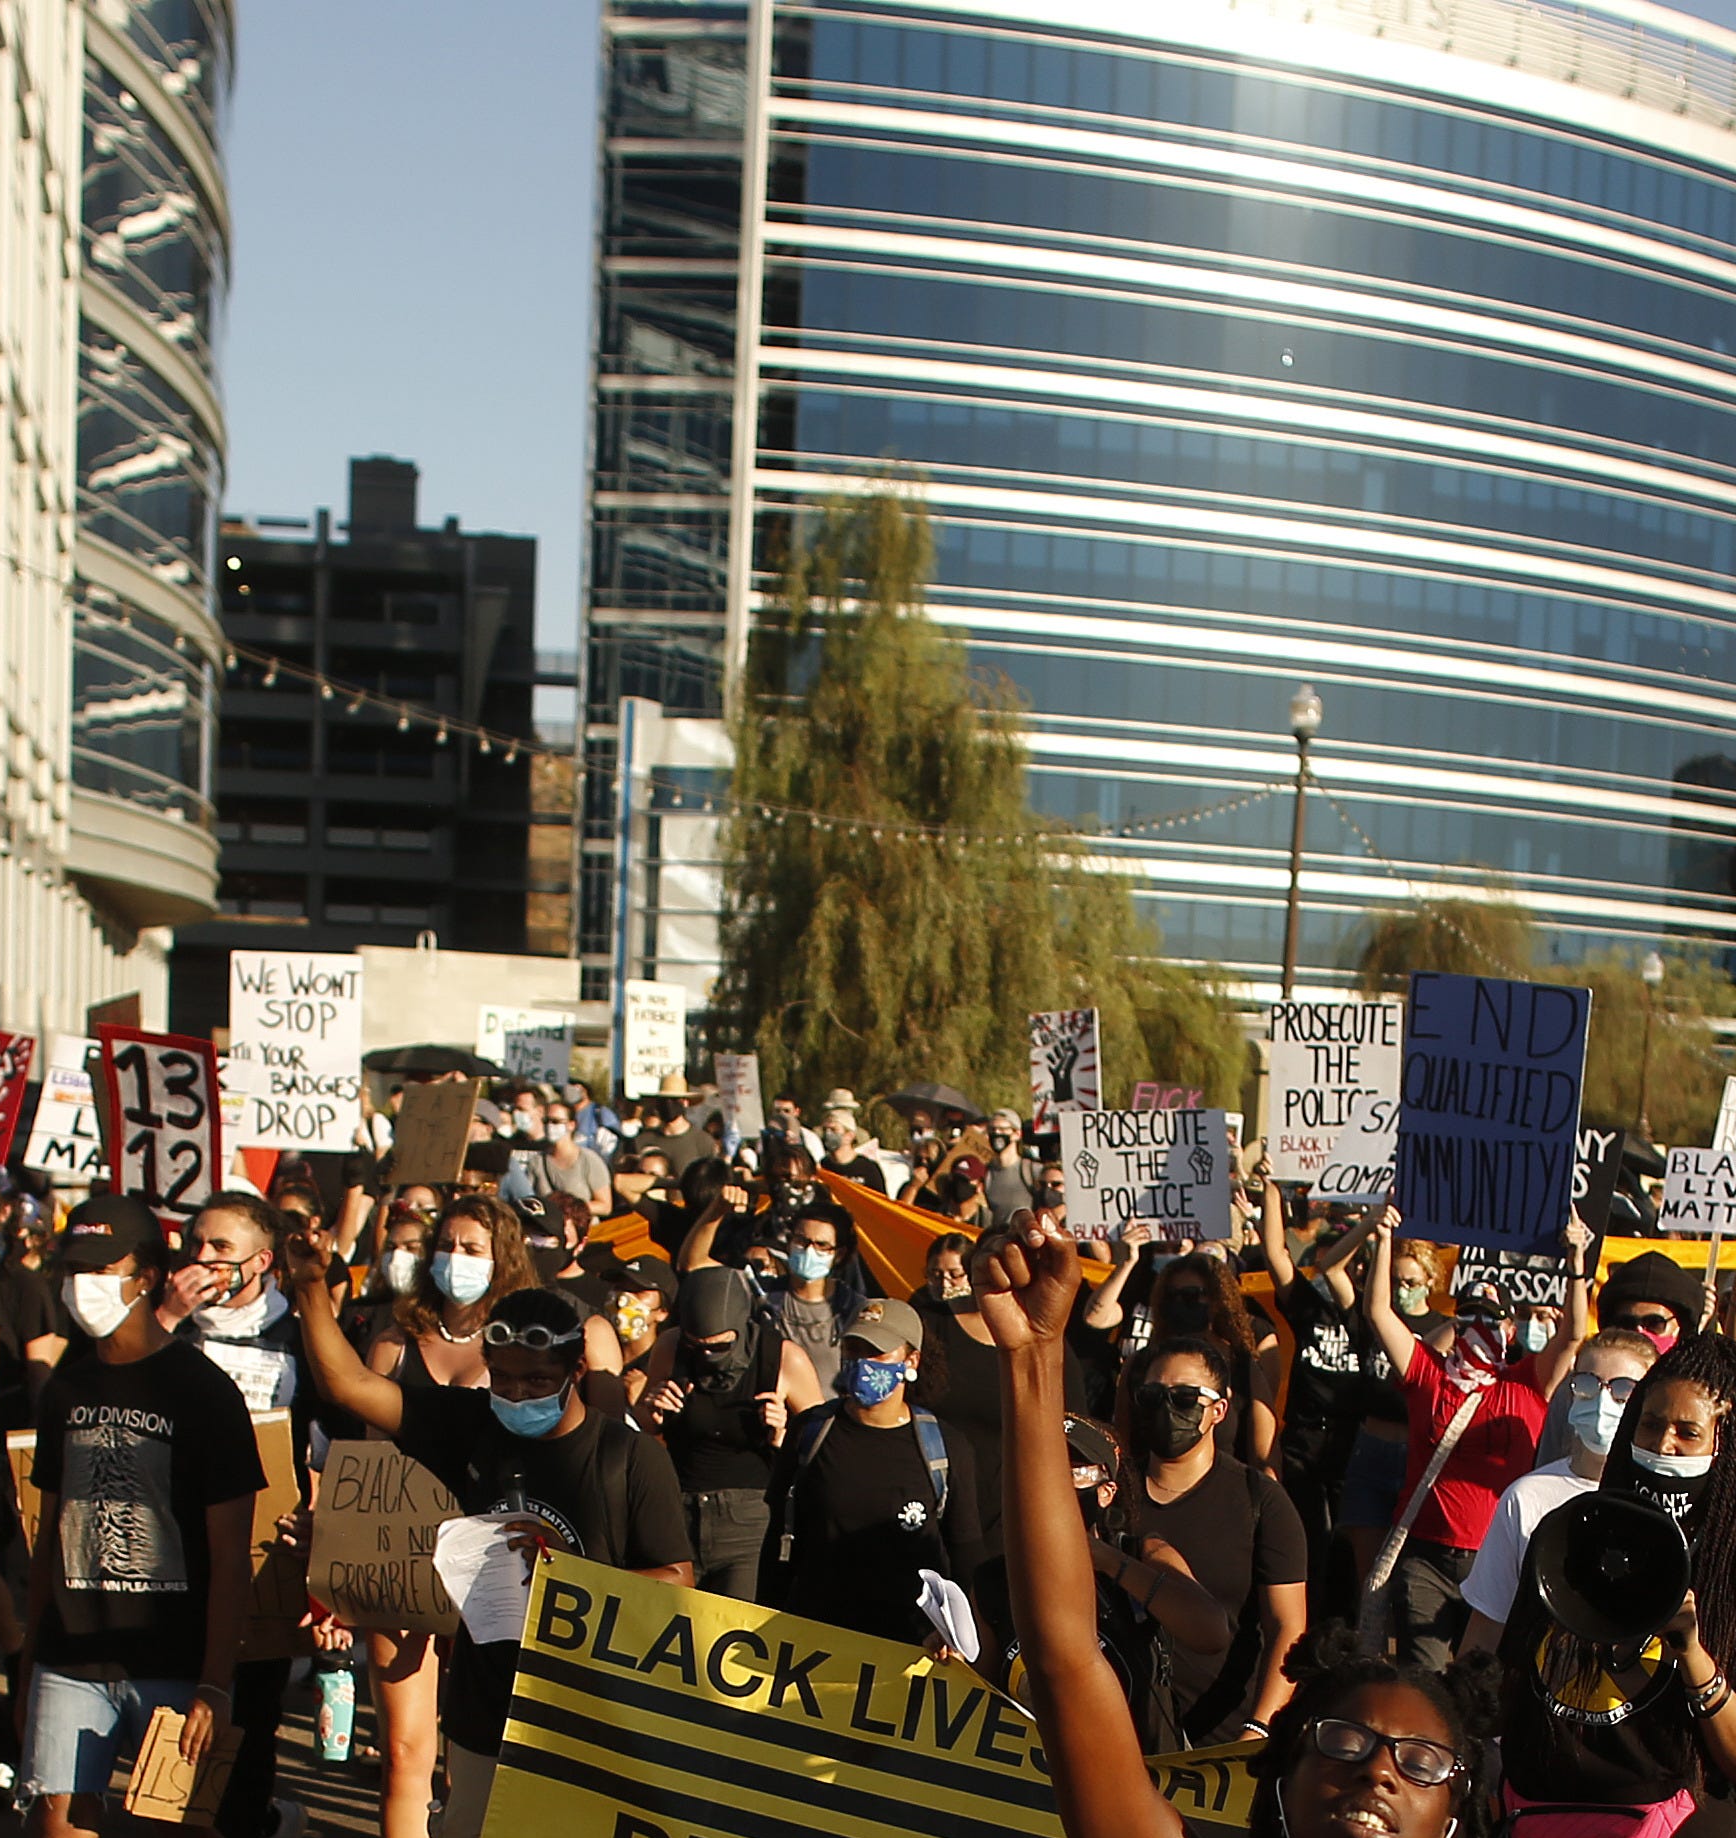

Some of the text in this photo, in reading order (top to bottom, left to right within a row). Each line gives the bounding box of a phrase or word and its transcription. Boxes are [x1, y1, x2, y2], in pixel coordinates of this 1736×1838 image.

[235, 958, 277, 995] WE
[257, 999, 337, 1040] STOP
[1270, 1002, 1397, 1046] PROSECUTE
[1408, 972, 1579, 1059] END
[260, 1042, 308, 1071] YOUR
[1305, 1045, 1360, 1083] THE
[112, 1043, 206, 1130] 13
[271, 1071, 360, 1103] BADGES
[1403, 1051, 1577, 1133] QUALIFIED
[251, 1098, 337, 1140] DROP
[1285, 1089, 1378, 1128] POLIC
[1082, 1110, 1209, 1149] PROSECUTE
[1280, 1135, 1322, 1153] BLACK
[126, 1128, 208, 1215] 12
[1116, 1150, 1170, 1182] THE
[1101, 1183, 1195, 1221] POLICE
[66, 1405, 174, 1437] JOY DIVISION
[331, 1454, 418, 1514] BLACK
[376, 1525, 391, 1551] IS
[541, 1507, 577, 1546] MATTER
[328, 1559, 425, 1616] PROBABLE
[533, 1576, 833, 1719] BLACK
